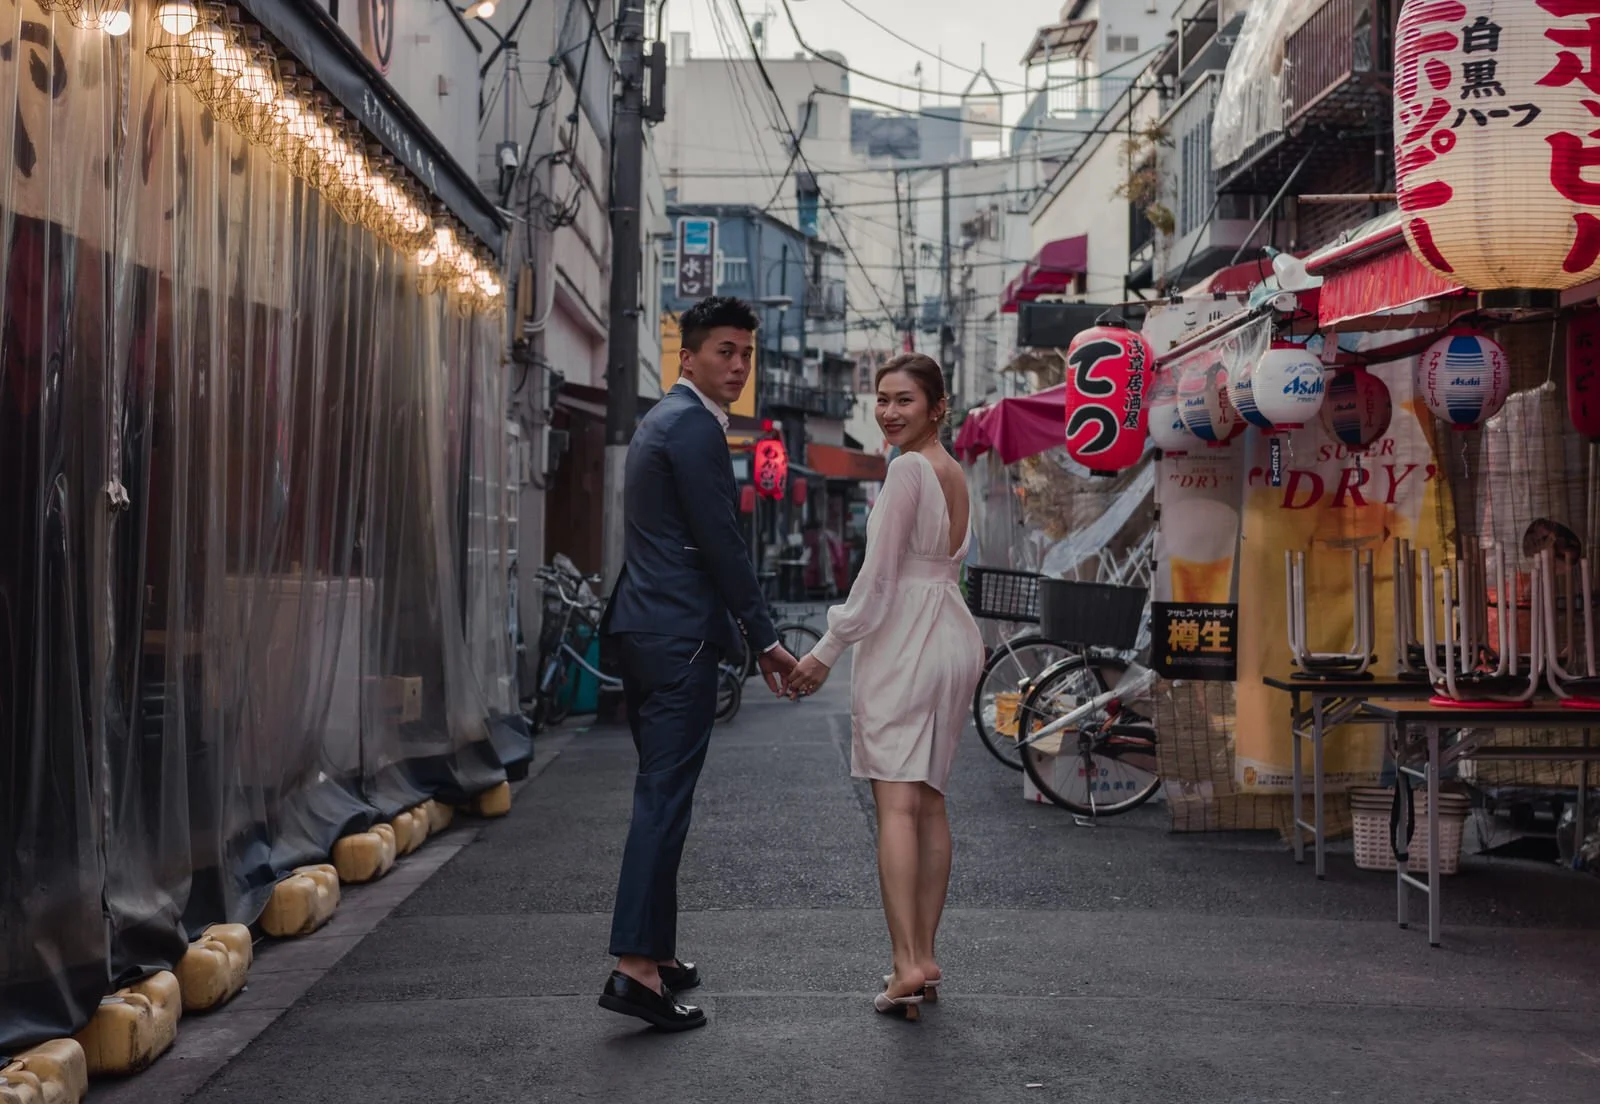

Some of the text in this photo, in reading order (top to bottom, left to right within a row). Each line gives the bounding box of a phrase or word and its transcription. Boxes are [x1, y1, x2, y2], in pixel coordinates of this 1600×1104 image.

[1460, 16, 1505, 100] 白黒
[1452, 103, 1541, 128] ハーフ
[1067, 338, 1124, 455] てつ
[1122, 339, 1145, 429] 浅草居酒屋
[1428, 351, 1441, 407] アサヒビール
[1450, 376, 1480, 386] Asahi
[1168, 619, 1232, 653] 樽生
